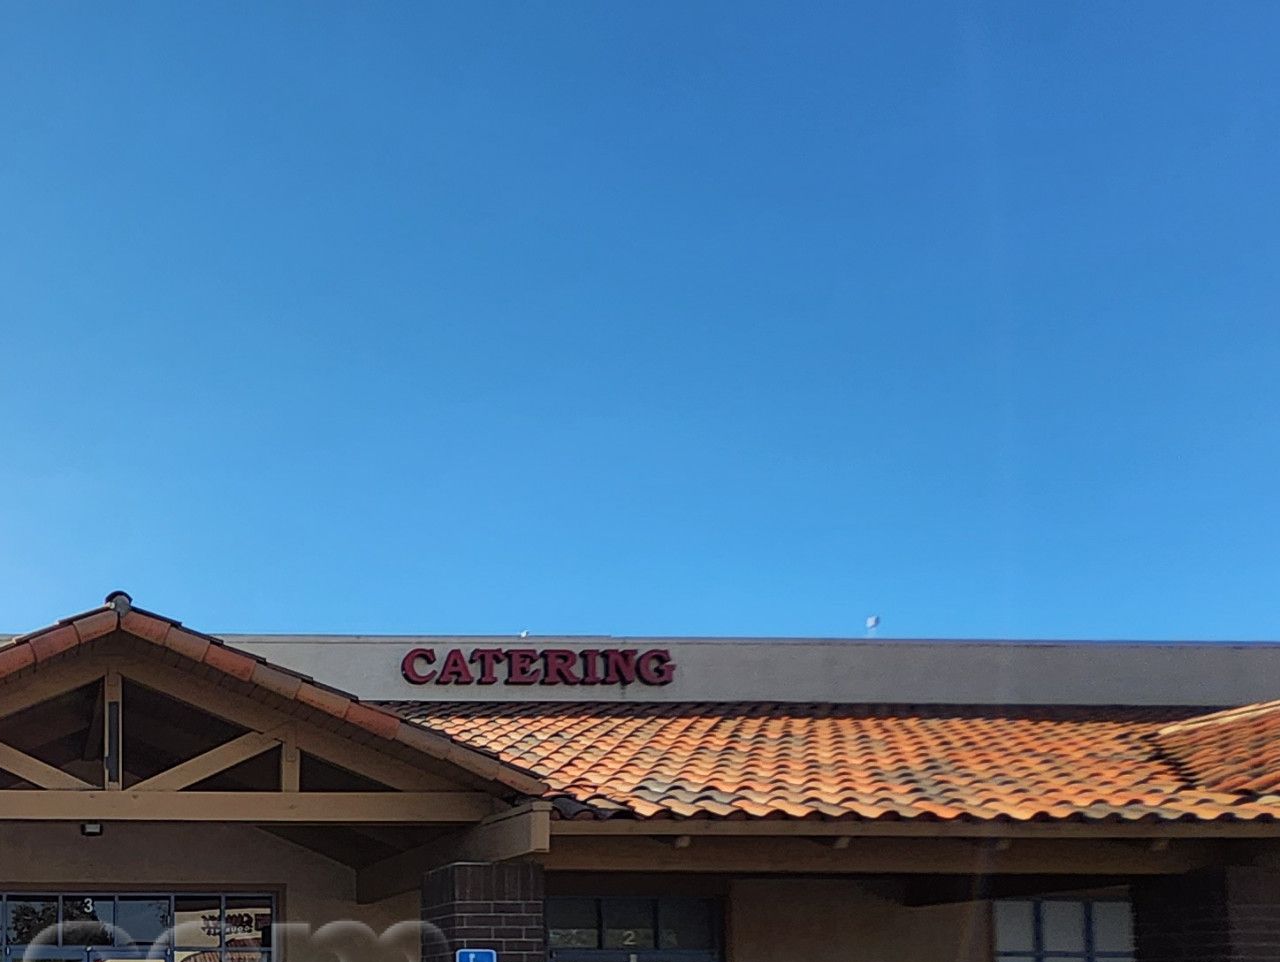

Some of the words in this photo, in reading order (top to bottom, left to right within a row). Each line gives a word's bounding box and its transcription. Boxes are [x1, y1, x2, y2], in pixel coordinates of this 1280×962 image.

[400, 648, 676, 686] CATERING
[84, 897, 93, 913] 3
[622, 930, 637, 945] 2
